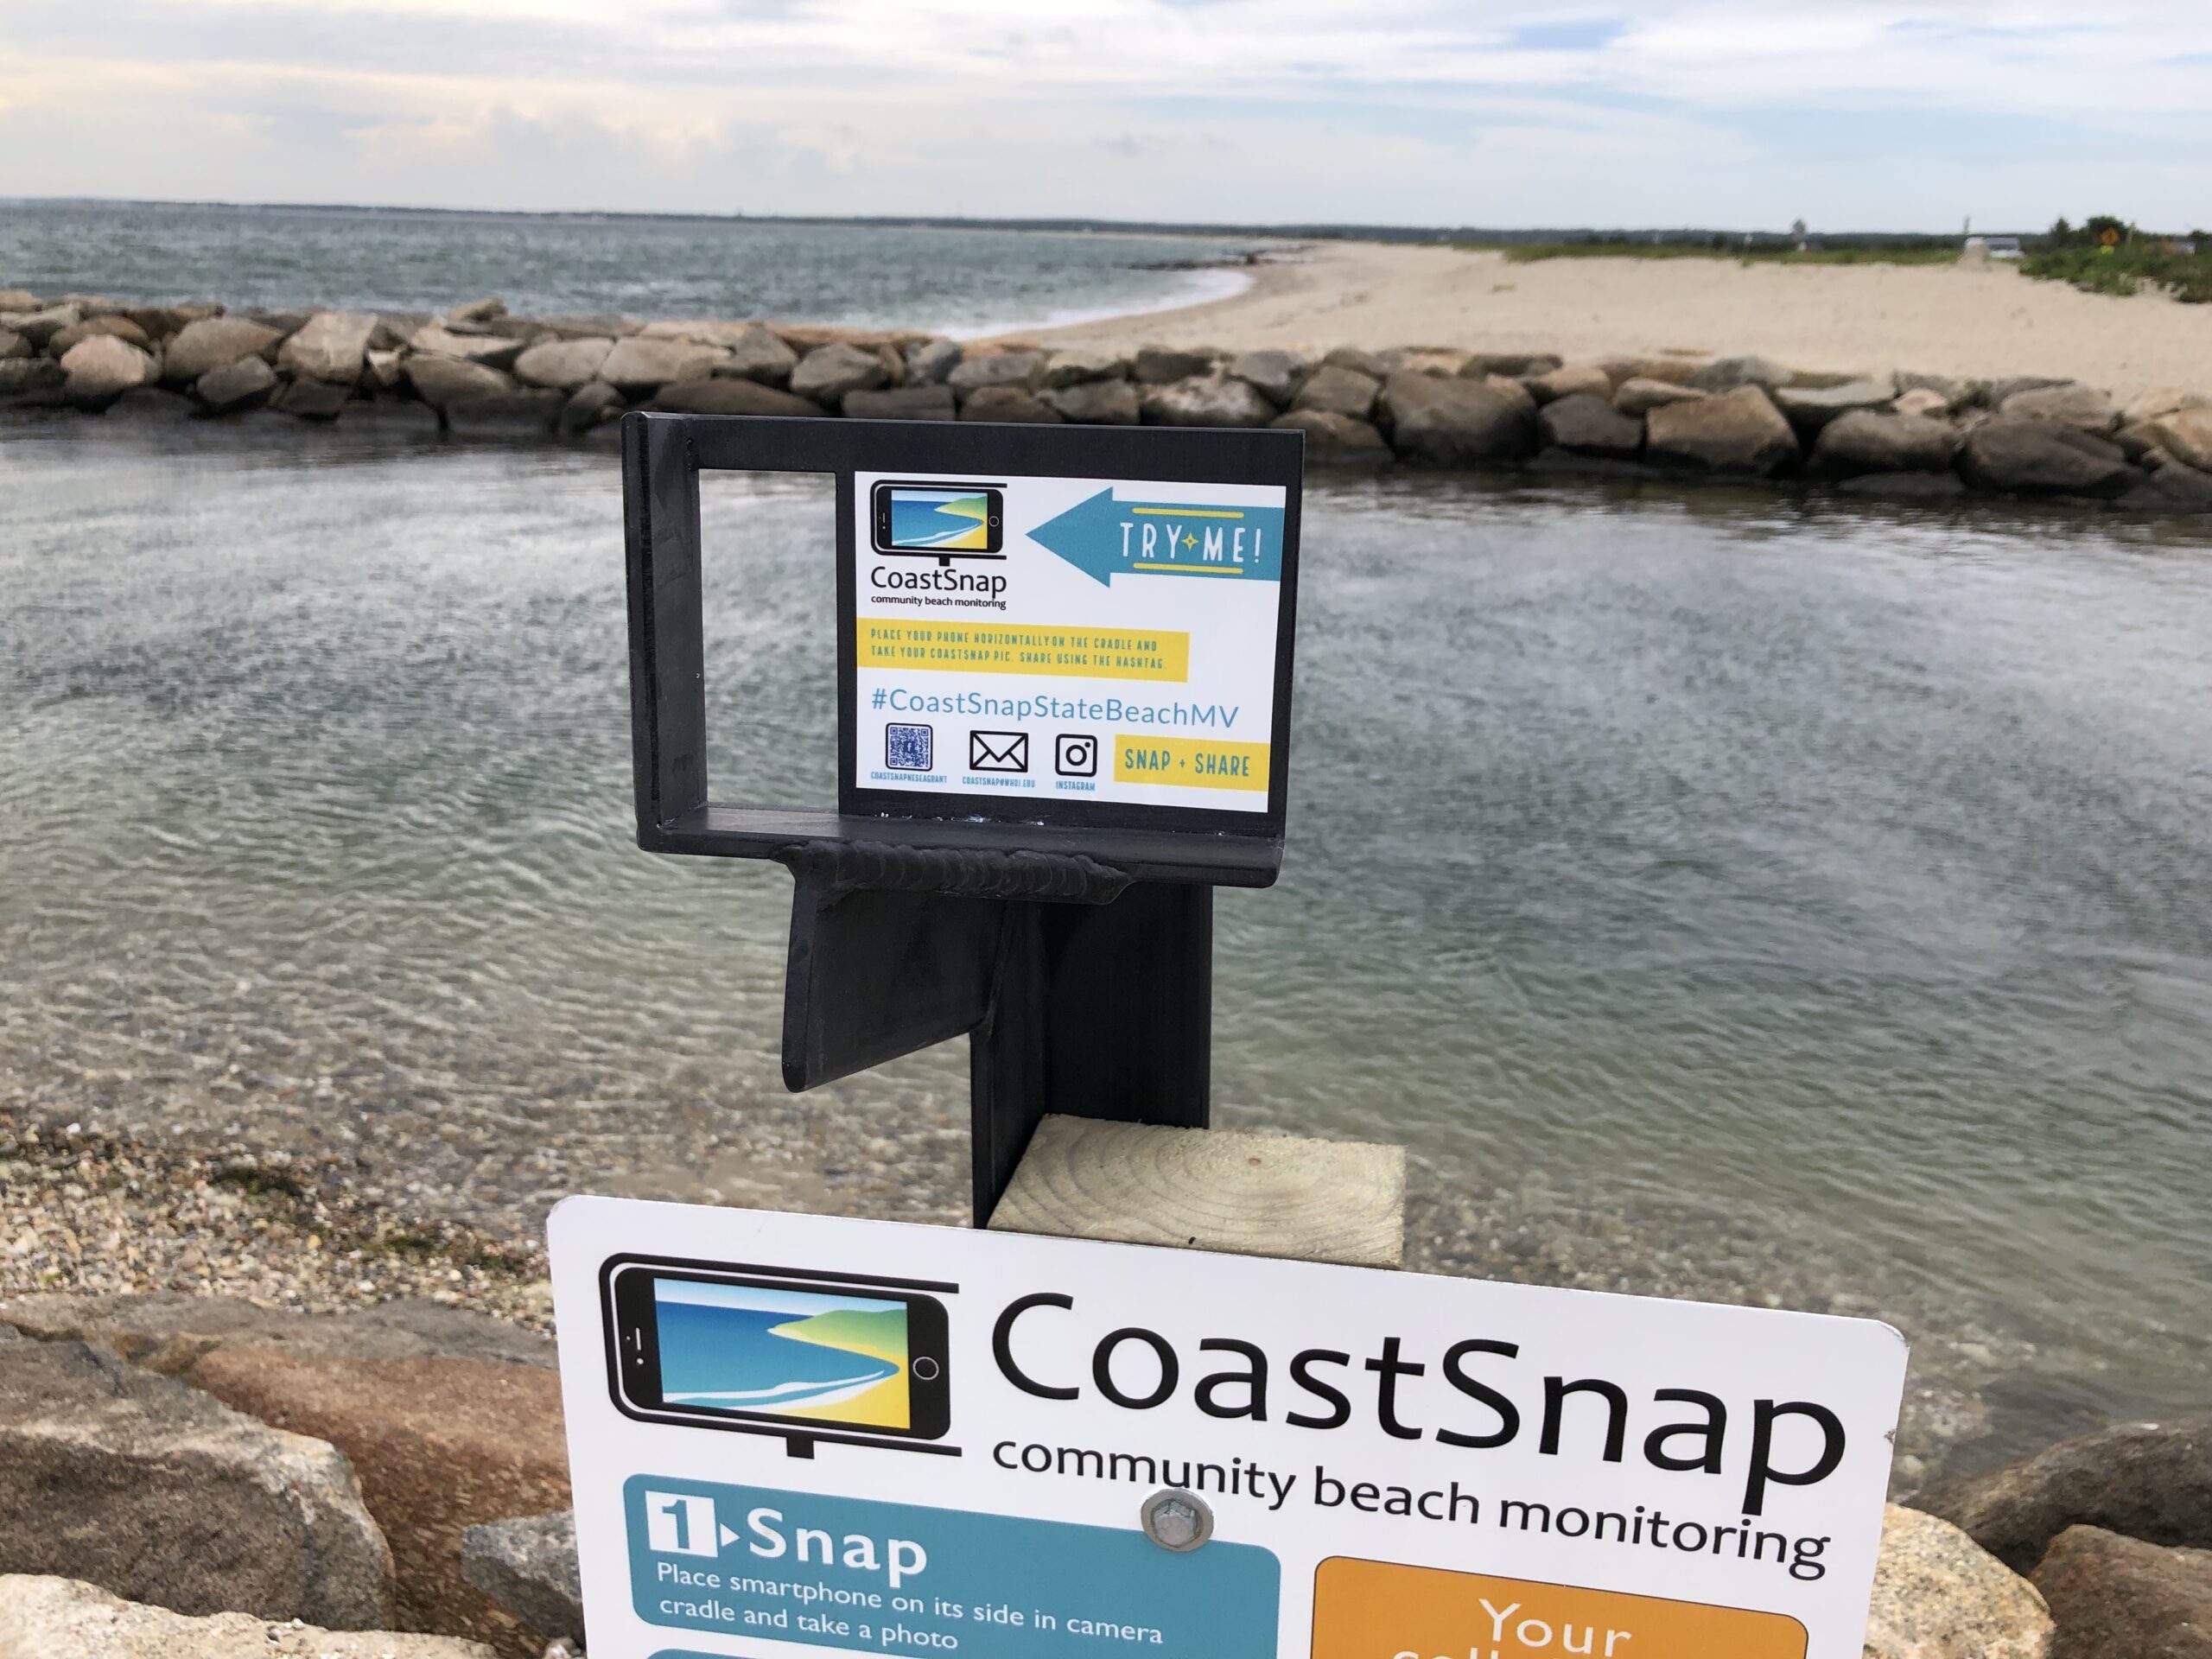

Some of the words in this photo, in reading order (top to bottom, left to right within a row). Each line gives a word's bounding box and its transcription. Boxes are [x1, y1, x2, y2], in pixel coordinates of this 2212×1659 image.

[1120, 522, 1183, 559] TRY
[1203, 526, 1262, 563] ME!
[870, 566, 1007, 601] CoastSnap
[870, 595, 924, 607] community
[925, 595, 953, 606] beach
[954, 595, 1007, 611] monitoring
[870, 628, 901, 640] PLACE
[906, 630, 932, 642] YOUR
[937, 631, 969, 644] PHONE
[1071, 636, 1088, 648] THE
[1093, 638, 1132, 651] CRADLE
[1136, 640, 1157, 652] AND
[871, 645, 895, 658] TAKE
[899, 646, 925, 658] YOUR
[1020, 652, 1051, 664] SHARE
[1057, 653, 1088, 665] USING
[1093, 654, 1110, 666] THE
[871, 688, 1239, 728] #CoastSnapStateBeachMV
[1125, 748, 1171, 771] SNAP
[1195, 753, 1250, 778] SHARE
[1056, 780, 1096, 791] INSTAGRAM
[992, 1293, 1846, 1516] CoastSnap
[993, 1440, 1297, 1510] community
[1315, 1465, 1478, 1523] beach
[1500, 1500, 1831, 1580] monitoring
[747, 1508, 926, 1588] Snap
[657, 1561, 721, 1588] Place
[729, 1576, 882, 1608] smartphone
[891, 1597, 924, 1613] on
[935, 1597, 963, 1618] its
[973, 1603, 1024, 1626] side
[1034, 1609, 1056, 1630] in
[1066, 1618, 1163, 1644] camera
[659, 1599, 735, 1622] cradle
[744, 1608, 788, 1629] and
[797, 1613, 849, 1636] take
[859, 1624, 873, 1639] a
[881, 1623, 958, 1649] photo
[1478, 1599, 1631, 1656] Your
